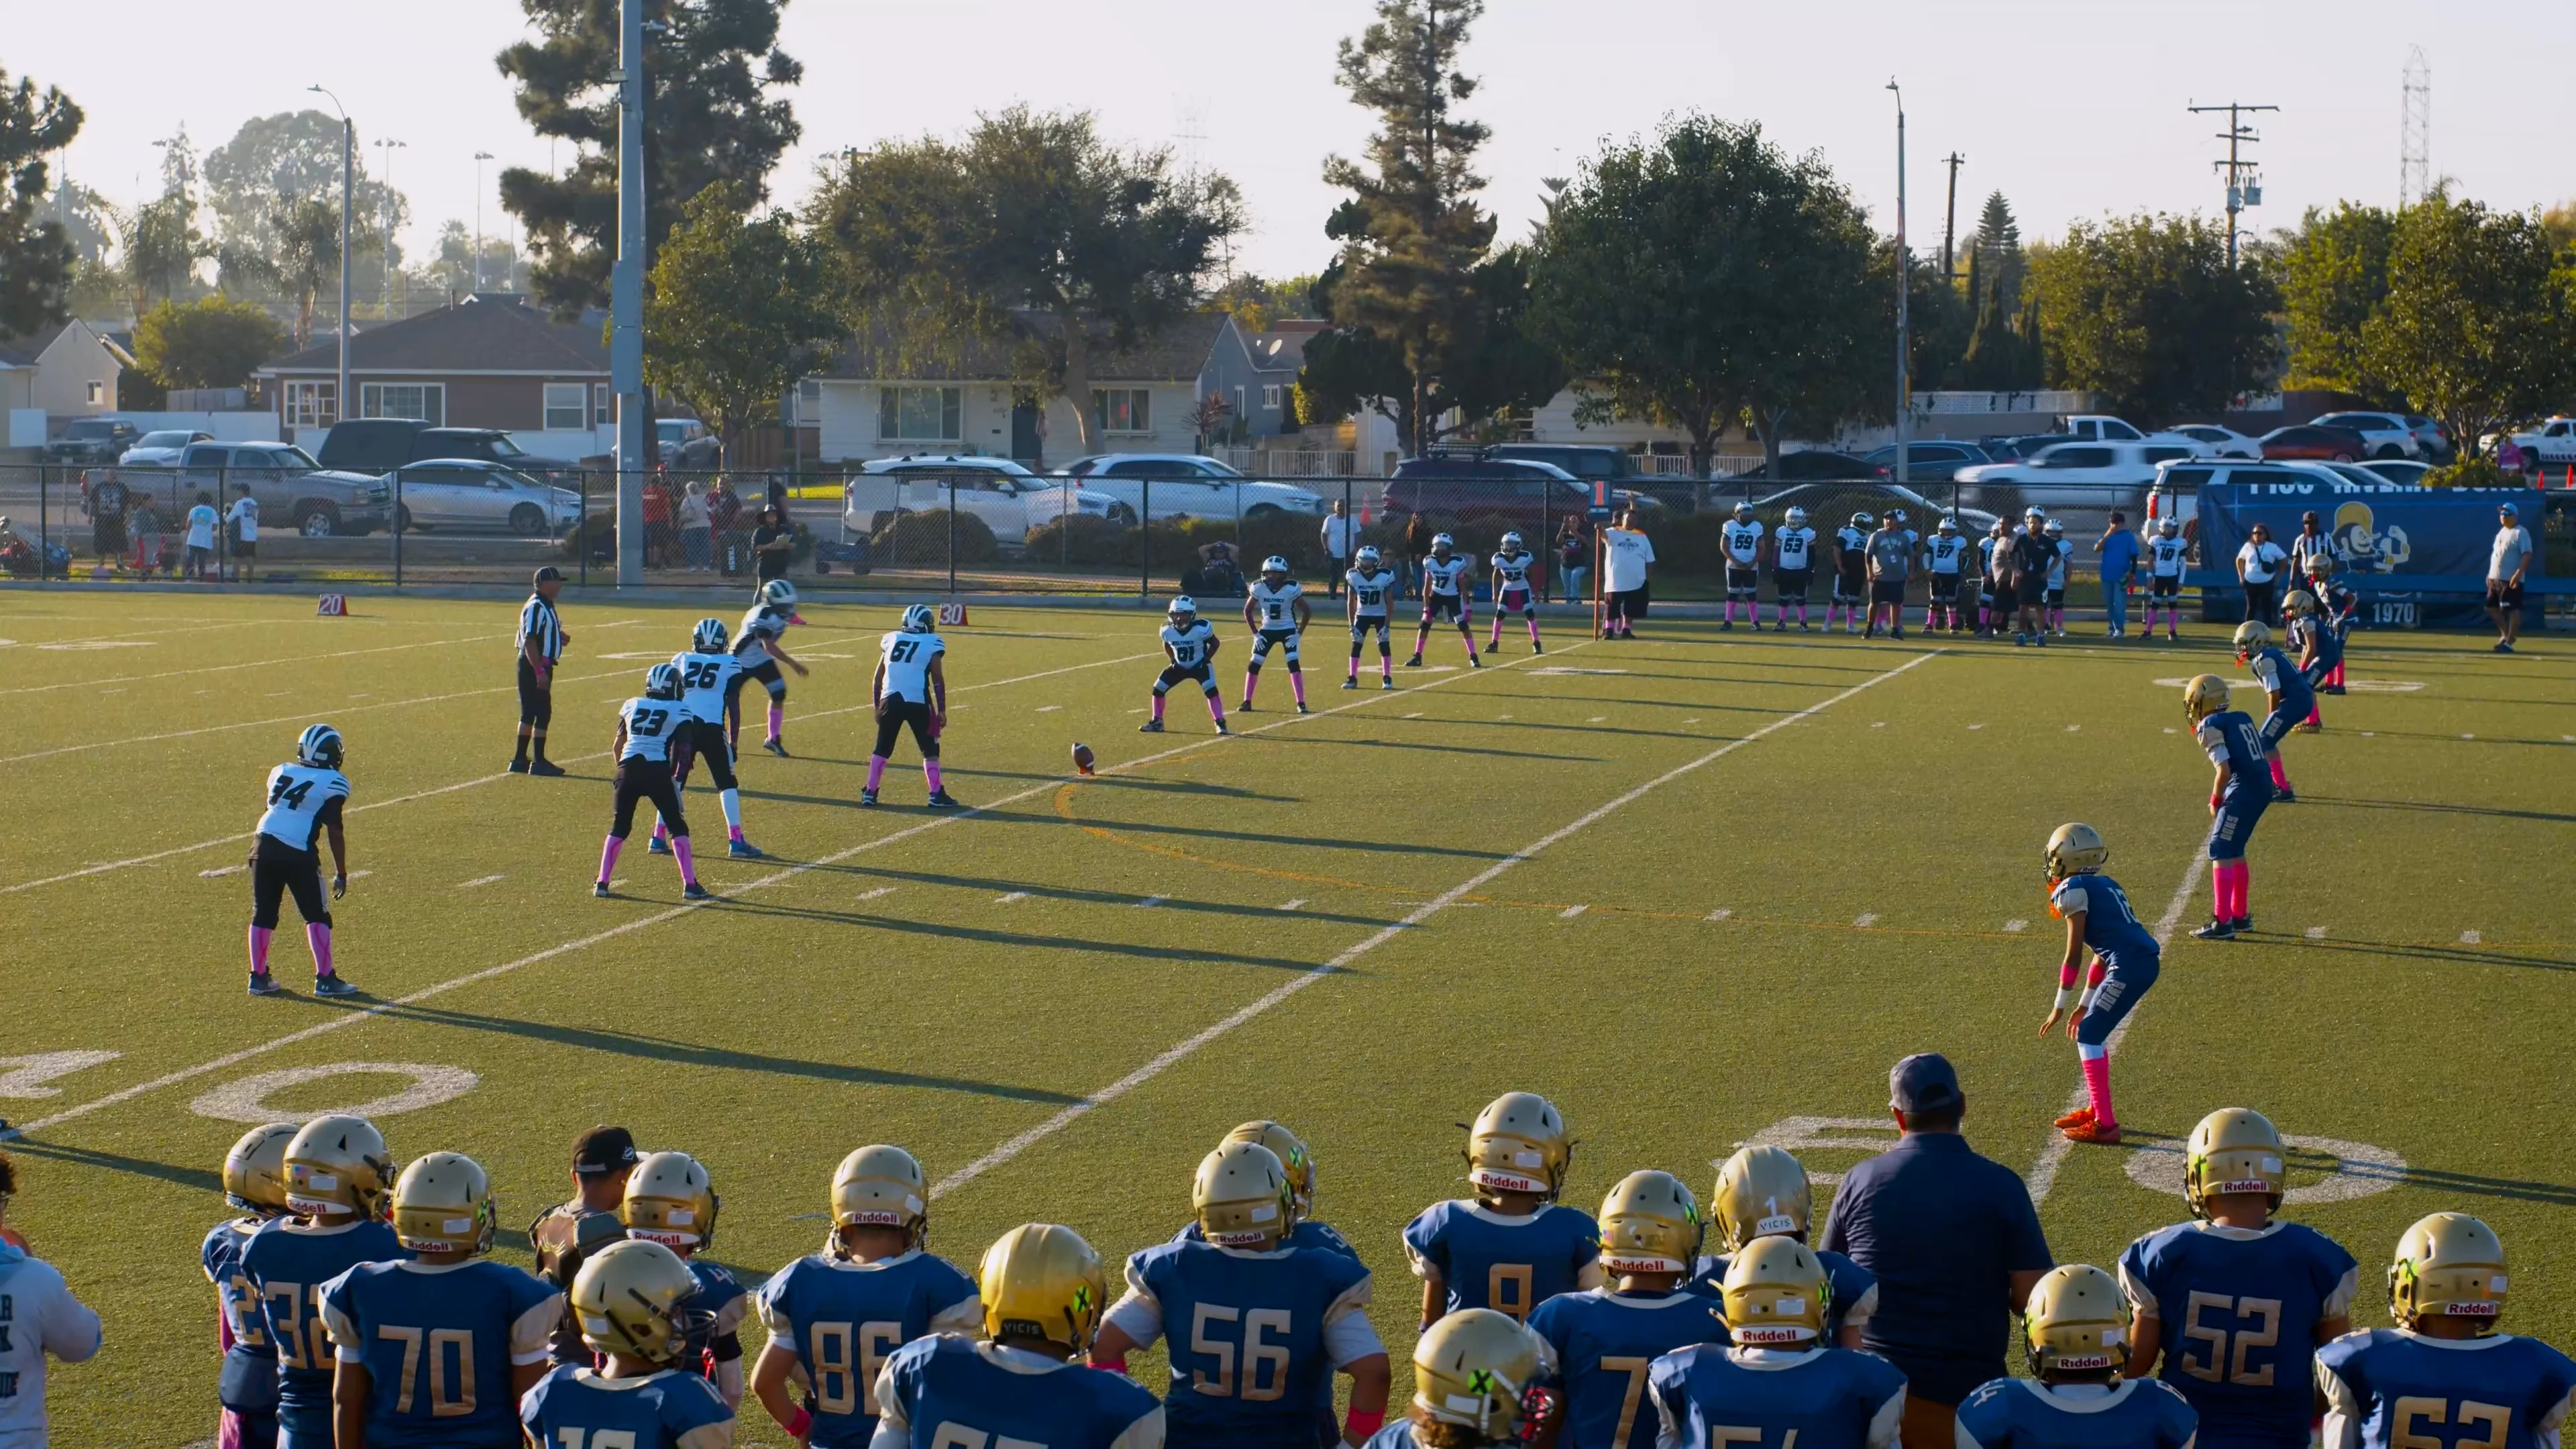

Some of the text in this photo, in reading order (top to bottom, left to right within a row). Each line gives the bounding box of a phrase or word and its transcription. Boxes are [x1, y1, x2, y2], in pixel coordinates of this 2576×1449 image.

[1594, 481, 1605, 505] 1
[1735, 535, 1754, 550] 69
[1784, 537, 1804, 553] 63
[727, 545, 735, 570] TRASH
[2159, 547, 2176, 561] 10
[1436, 576, 1450, 589] 17
[319, 595, 341, 615] 20
[2373, 603, 2414, 623] 1970
[940, 603, 963, 625] 30
[890, 640, 920, 663] 61
[1177, 646, 1195, 662] 81
[684, 661, 721, 689] 26
[631, 708, 669, 737] 23
[268, 775, 315, 810] 34
[1481, 1174, 1529, 1191] Riddell
[2224, 1181, 2267, 1191] Riddell
[288, 1199, 327, 1213] Riddell
[1764, 1196, 1777, 1217] 1
[855, 1213, 898, 1224] Riddell
[1760, 1218, 1791, 1231] VICIS
[408, 1240, 449, 1251] Riddell
[635, 1232, 680, 1244] Riddell
[1220, 1232, 1262, 1243] Riddell
[1612, 1259, 1664, 1271] Riddell
[231, 1275, 266, 1345] 2
[2449, 1303, 2494, 1314] Riddell
[265, 1281, 336, 1369] 32
[1003, 1322, 1040, 1335] VICIS
[1742, 1330, 1796, 1342] Riddell
[2182, 1289, 2282, 1386] 52
[1191, 1301, 1291, 1401] 56
[378, 1324, 477, 1417] 70
[810, 1321, 902, 1415] 86
[2061, 1356, 2108, 1368] Riddell
[1601, 1356, 1649, 1449] 7
